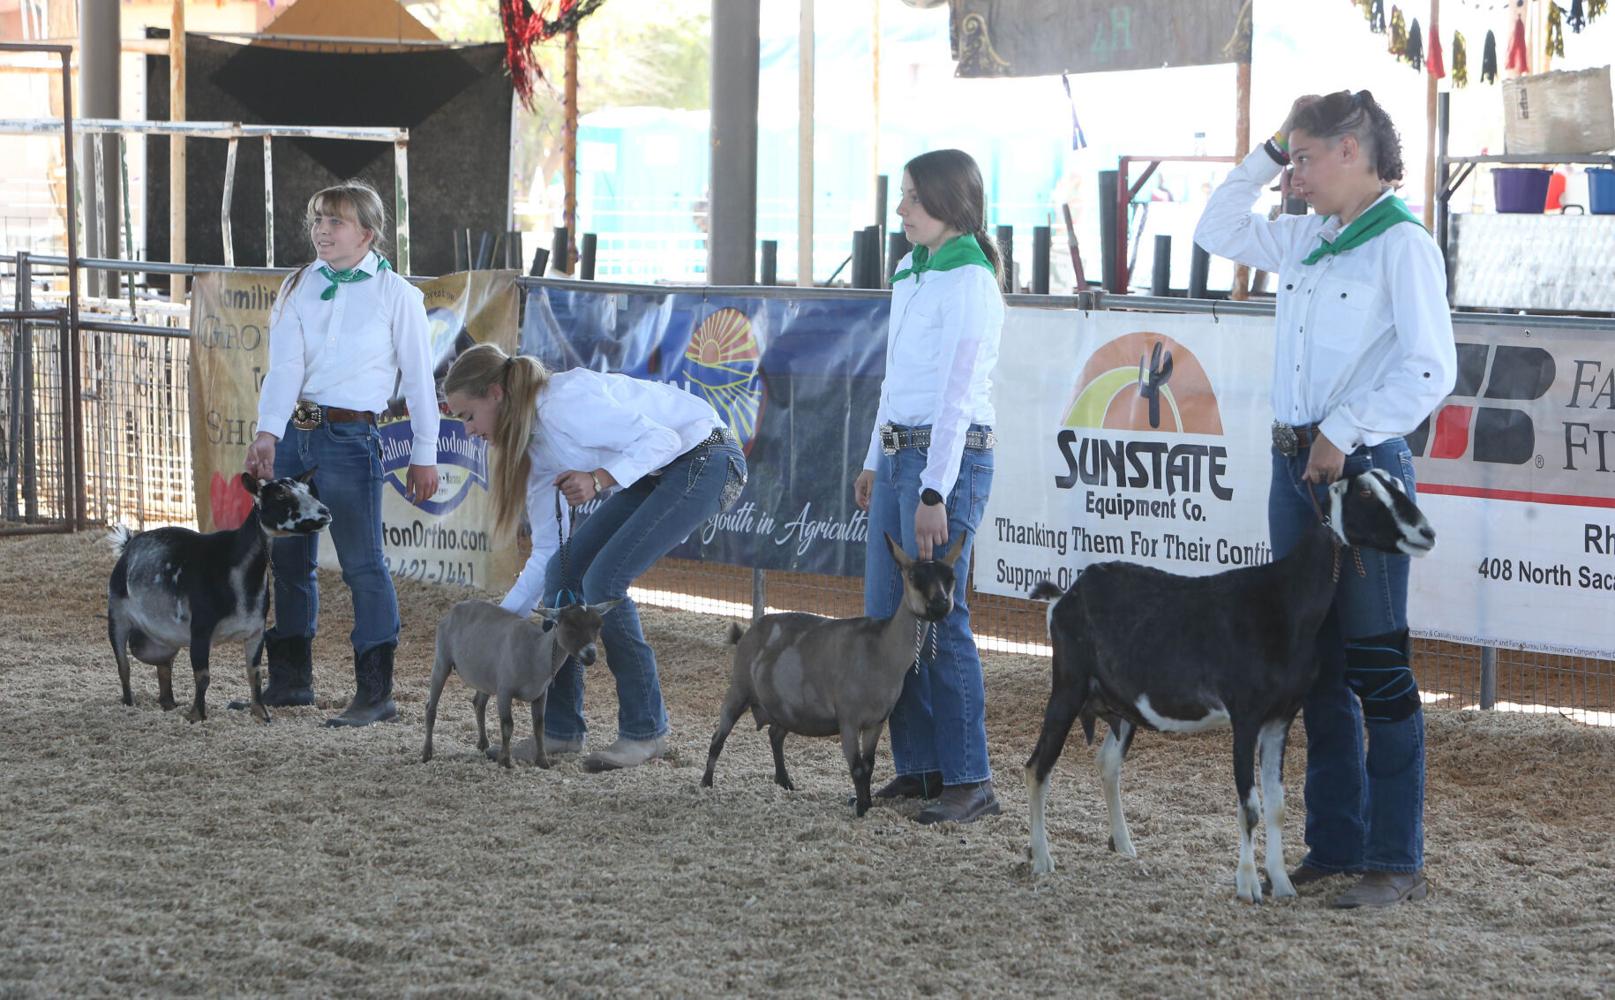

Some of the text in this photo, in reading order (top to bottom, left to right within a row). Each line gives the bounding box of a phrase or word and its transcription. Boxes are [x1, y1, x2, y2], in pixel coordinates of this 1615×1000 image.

[222, 283, 277, 310] amilie
[201, 314, 270, 351] GRO
[1055, 430, 1233, 501] SUNSTATE
[1562, 422, 1615, 473] FI
[702, 502, 756, 545] youth
[756, 511, 776, 535] in
[1086, 491, 1206, 522] Equipment Co.
[995, 517, 1067, 555] Thanking
[1072, 526, 1124, 554] Them
[1131, 530, 1158, 558] For
[1163, 533, 1211, 562] Their
[997, 558, 1051, 592] Support
[1478, 557, 1615, 591] 408 North Sac
